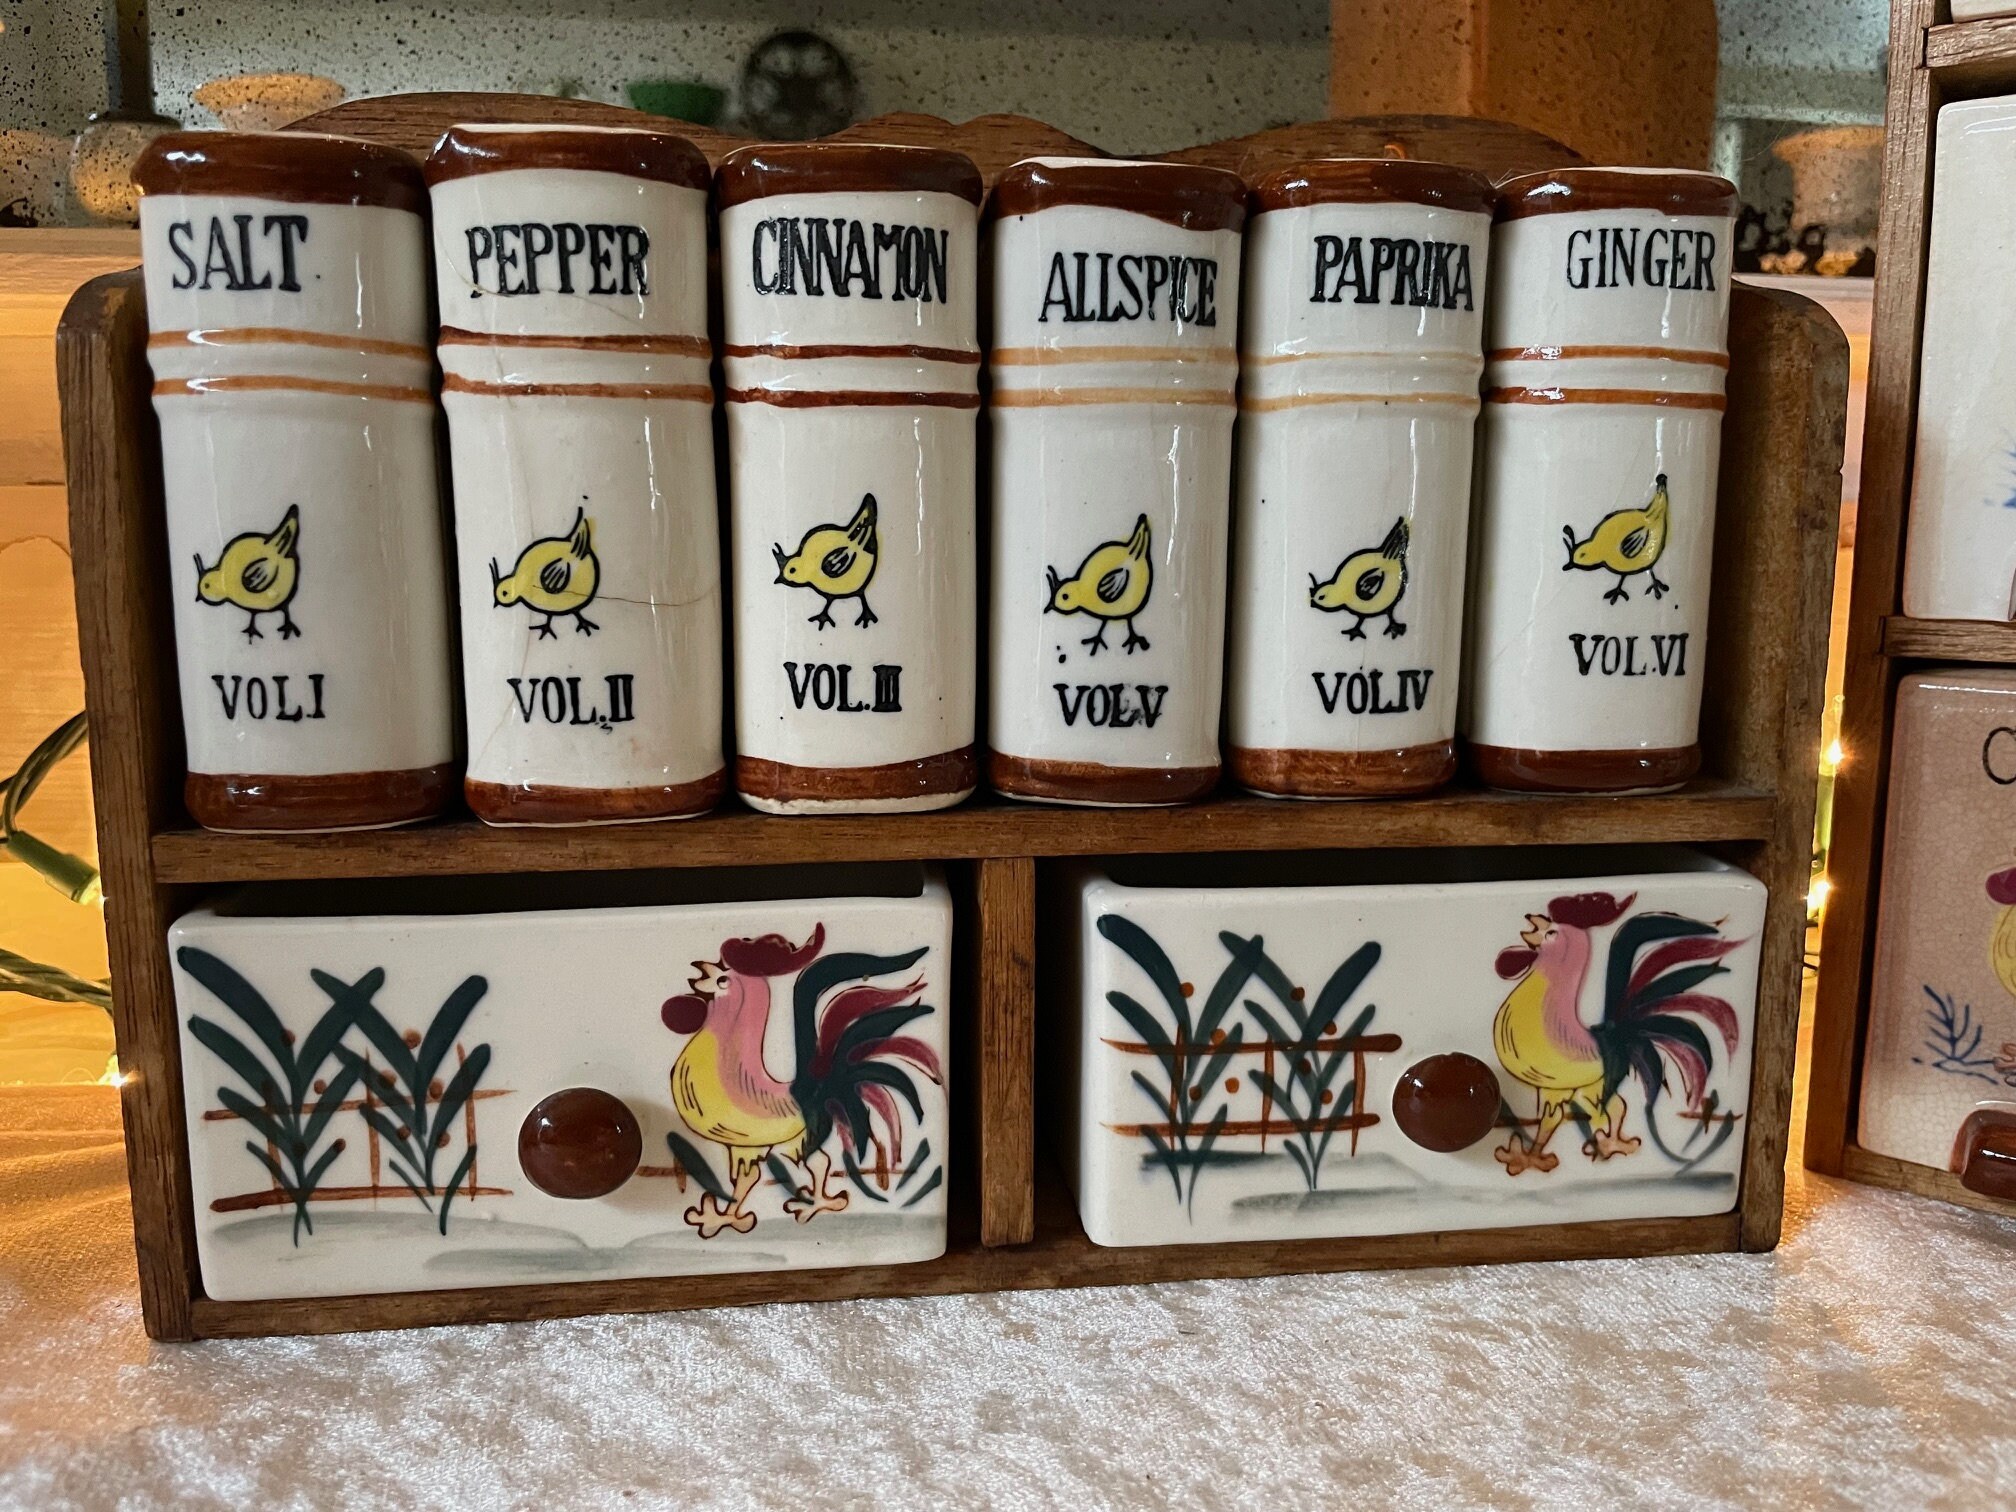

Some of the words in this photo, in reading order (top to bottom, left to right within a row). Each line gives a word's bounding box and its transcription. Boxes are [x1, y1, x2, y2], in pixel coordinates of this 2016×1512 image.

[168, 214, 308, 292] SALT
[464, 222, 651, 299] PEPPER
[752, 216, 949, 304] CINNAMON
[1037, 252, 1218, 327] ALLSPICE
[1309, 234, 1474, 312] PAPRIKA
[1566, 228, 1716, 292] GINGER
